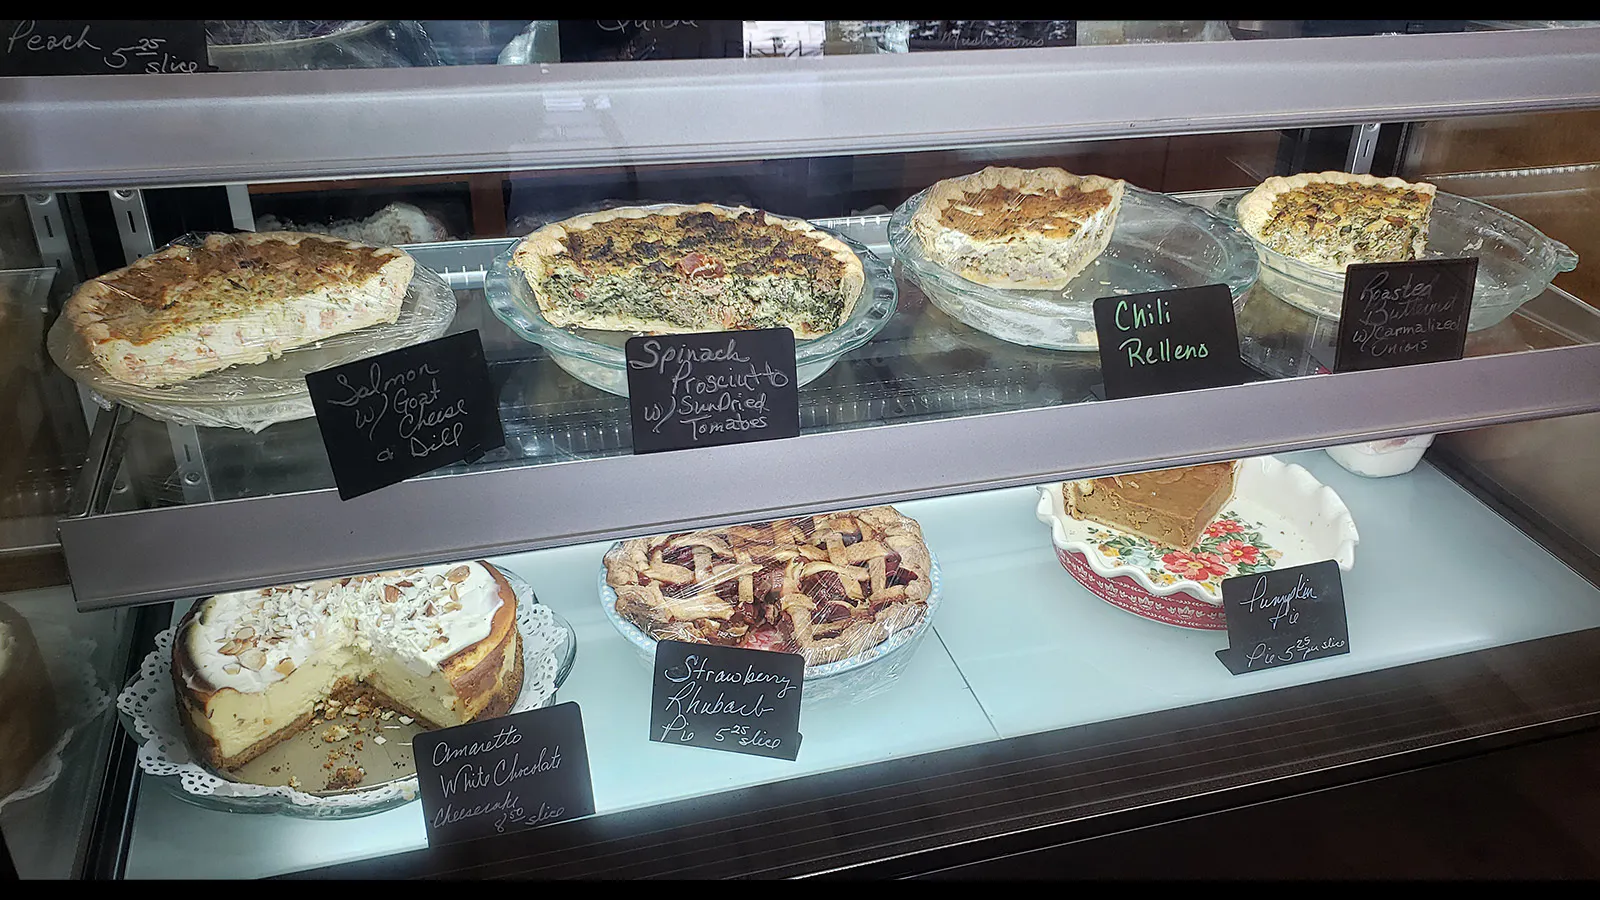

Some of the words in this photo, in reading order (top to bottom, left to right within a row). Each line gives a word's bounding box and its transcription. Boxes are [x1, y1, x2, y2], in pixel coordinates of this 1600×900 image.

[8, 20, 101, 54] Peach
[145, 53, 198, 74] slice
[1360, 271, 1440, 312] Roasted
[1115, 298, 1170, 331] Chili
[629, 339, 751, 374] Spinach
[1119, 338, 1209, 368] Relleno
[327, 363, 440, 406] Salmon
[672, 360, 789, 394] Prosciutto
[394, 378, 440, 415] Goat
[400, 399, 468, 439] Cheese
[680, 413, 768, 440] Tomatoes
[411, 423, 463, 457] Dill
[1240, 574, 1317, 612] Pumpkin
[1269, 603, 1299, 630] Pie
[1246, 643, 1275, 668] Pie
[1321, 638, 1345, 650] slice
[664, 654, 797, 699] Strawberry
[665, 681, 774, 717] Rhubarb
[661, 714, 695, 742] Pie
[738, 730, 781, 749] slice
[440, 764, 491, 798] White
[493, 745, 562, 787] Chocolate
[433, 791, 519, 829] Cheesecake
[525, 802, 565, 825] slice
